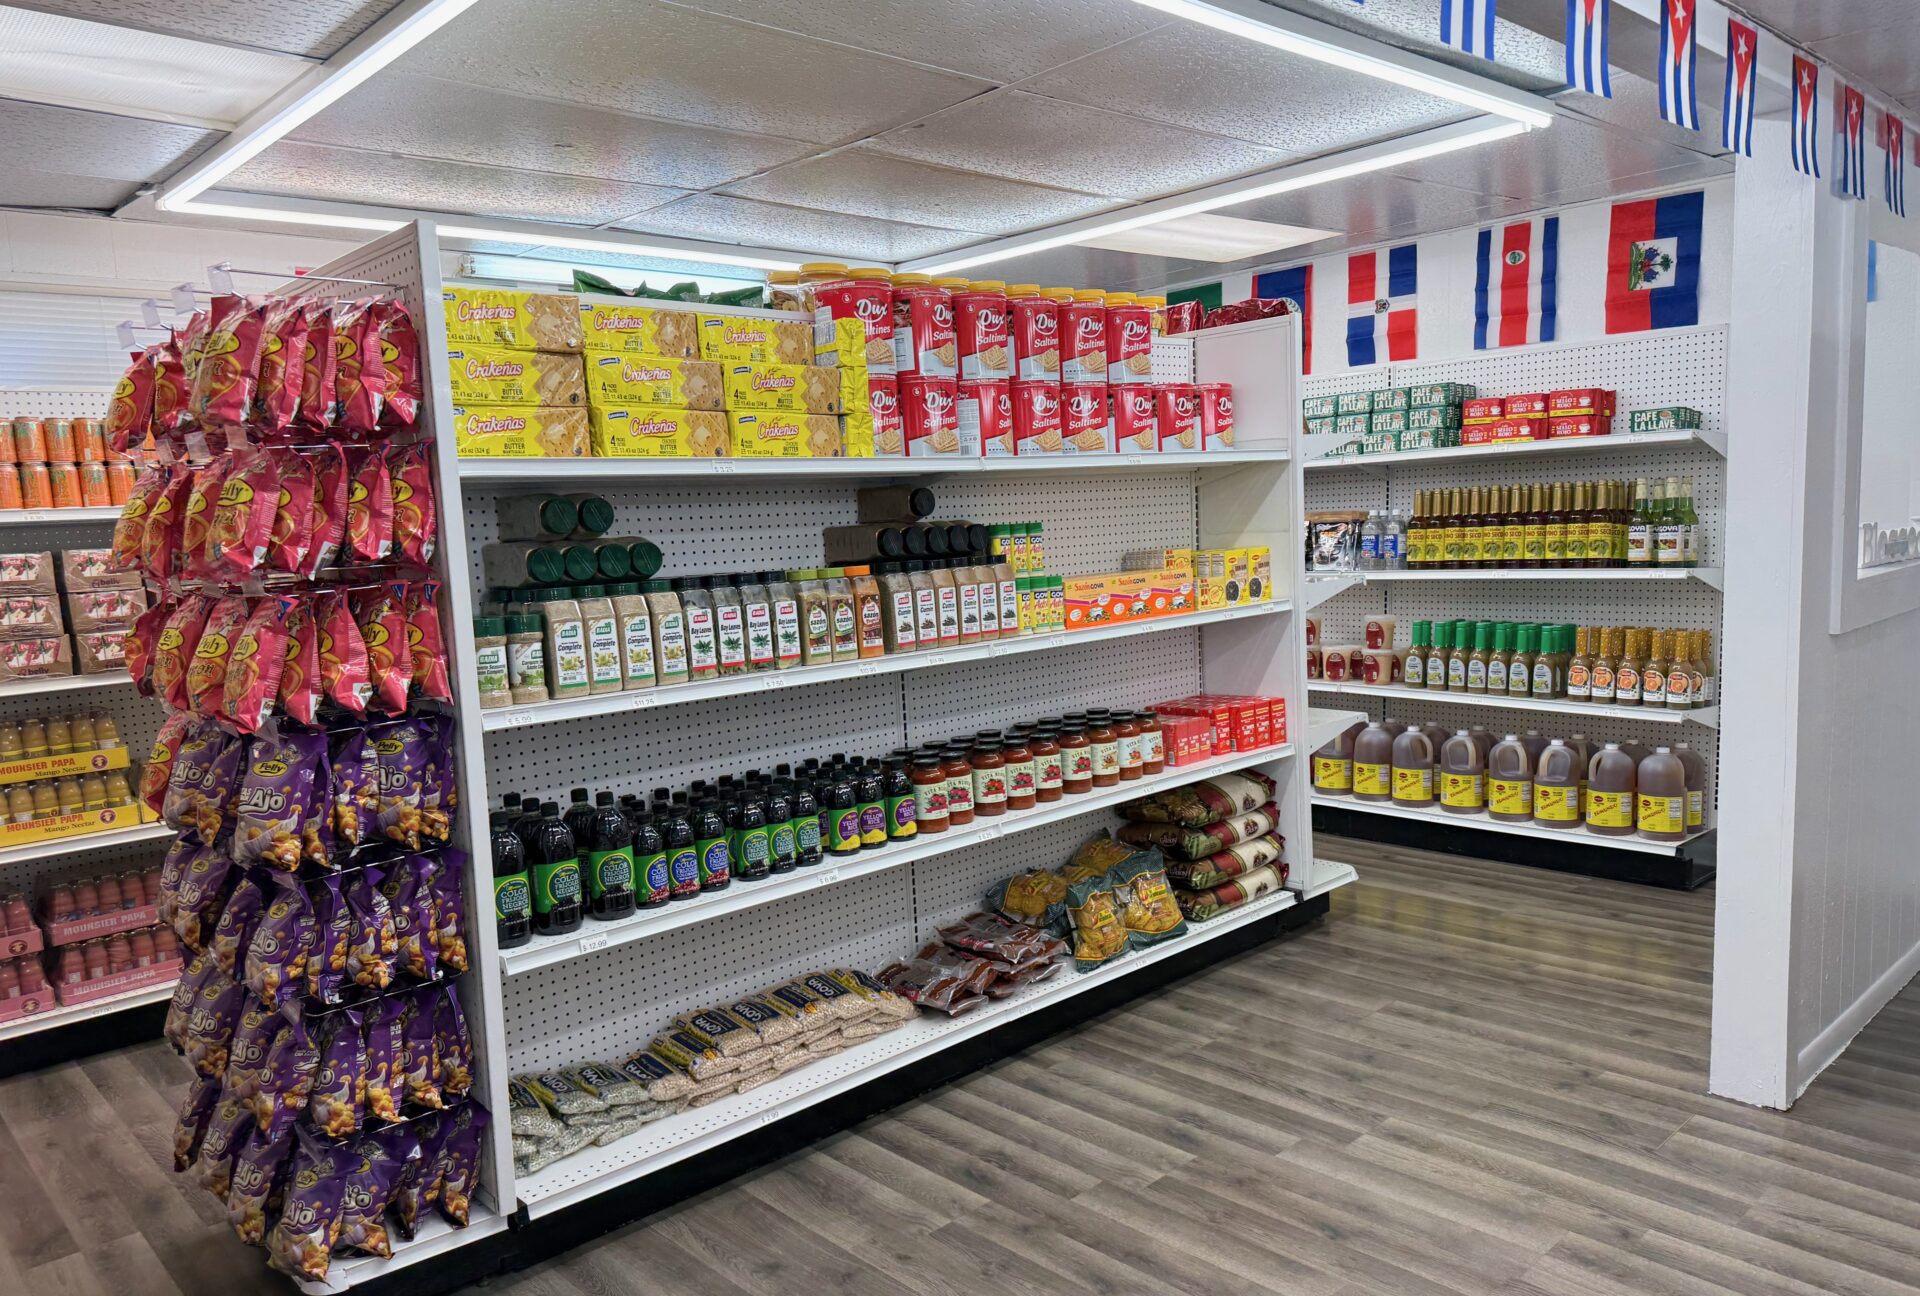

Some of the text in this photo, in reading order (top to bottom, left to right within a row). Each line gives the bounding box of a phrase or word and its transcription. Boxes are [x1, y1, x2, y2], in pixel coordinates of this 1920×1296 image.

[458, 302, 515, 322] Crakeñas
[857, 299, 887, 316] Dux
[594, 312, 643, 330] Crakeñas
[979, 309, 1004, 325] Dux
[1079, 317, 1104, 332] Dux
[1125, 321, 1148, 336] Dux
[724, 327, 766, 344] Crakeñas
[977, 334, 1006, 345] Saltines
[1123, 342, 1150, 353] Saltines
[466, 359, 522, 380] Crakeñas
[623, 364, 672, 383] Crakeñas
[752, 372, 795, 390] Crakeñas
[602, 383, 606, 393] 4
[1412, 387, 1430, 396] CAFE
[734, 389, 738, 399] 4
[872, 391, 896, 407] Dux
[1374, 392, 1392, 401] CAFE
[1412, 394, 1445, 405] LA LLAVE
[926, 392, 953, 408] Dux
[1035, 395, 1058, 410] Dux
[1071, 397, 1099, 410] Dux
[1305, 400, 1322, 408] CAFE
[1375, 399, 1406, 409] LA LLAVE
[1314, 406, 1333, 415] LLAVE
[1410, 411, 1428, 419] CAFE
[924, 416, 956, 428] Saltines
[1373, 414, 1390, 423] CAFE
[1410, 418, 1443, 427] LA LLAVE
[1635, 412, 1657, 422] CAFE
[467, 415, 525, 435] Crakeñas
[630, 417, 677, 436] Crakeñas
[1069, 417, 1102, 429] Saltines
[1383, 421, 1404, 430] LLAVE
[1635, 419, 1675, 431] LA LLAVE
[758, 422, 799, 439] Crakeñas
[611, 435, 615, 446] 4
[1363, 435, 1382, 443] CAFE
[1401, 432, 1419, 441] CAFE
[741, 438, 745, 448] 4
[1364, 442, 1396, 452] LA LLAVE
[1401, 439, 1433, 449] LA LLAVE
[220, 484, 245, 499] elly
[377, 742, 401, 752] Pelly
[51, 758, 75, 768] PAPA
[254, 762, 285, 774] Pelly
[35, 766, 86, 777] Mango Nectar
[253, 788, 285, 810] Ajo
[60, 814, 84, 823] PAPA
[44, 821, 96, 833] Mango Nectar
[747, 840, 768, 849] COLOR
[603, 862, 628, 872] COLOR
[604, 868, 629, 877] FRIJOLES
[554, 874, 578, 884] COLOR
[605, 874, 629, 882] NEGROS
[501, 887, 527, 899] COLOR
[556, 886, 580, 895] NEGROS
[503, 900, 528, 909] NEGROS
[121, 911, 147, 922] PAPA
[589, 940, 607, 949] 12.99
[132, 969, 156, 980] PAPA
[807, 978, 834, 998] GOYA
[733, 1003, 760, 1022] GOYA
[190, 1014, 217, 1035] Ajo
[694, 1018, 721, 1035] GOYA
[236, 1039, 262, 1063] Ajo
[582, 1068, 608, 1086] GOYA
[542, 1075, 568, 1092] GOYA
[237, 1165, 264, 1188] Ajo
[284, 1200, 315, 1227] Ajo
